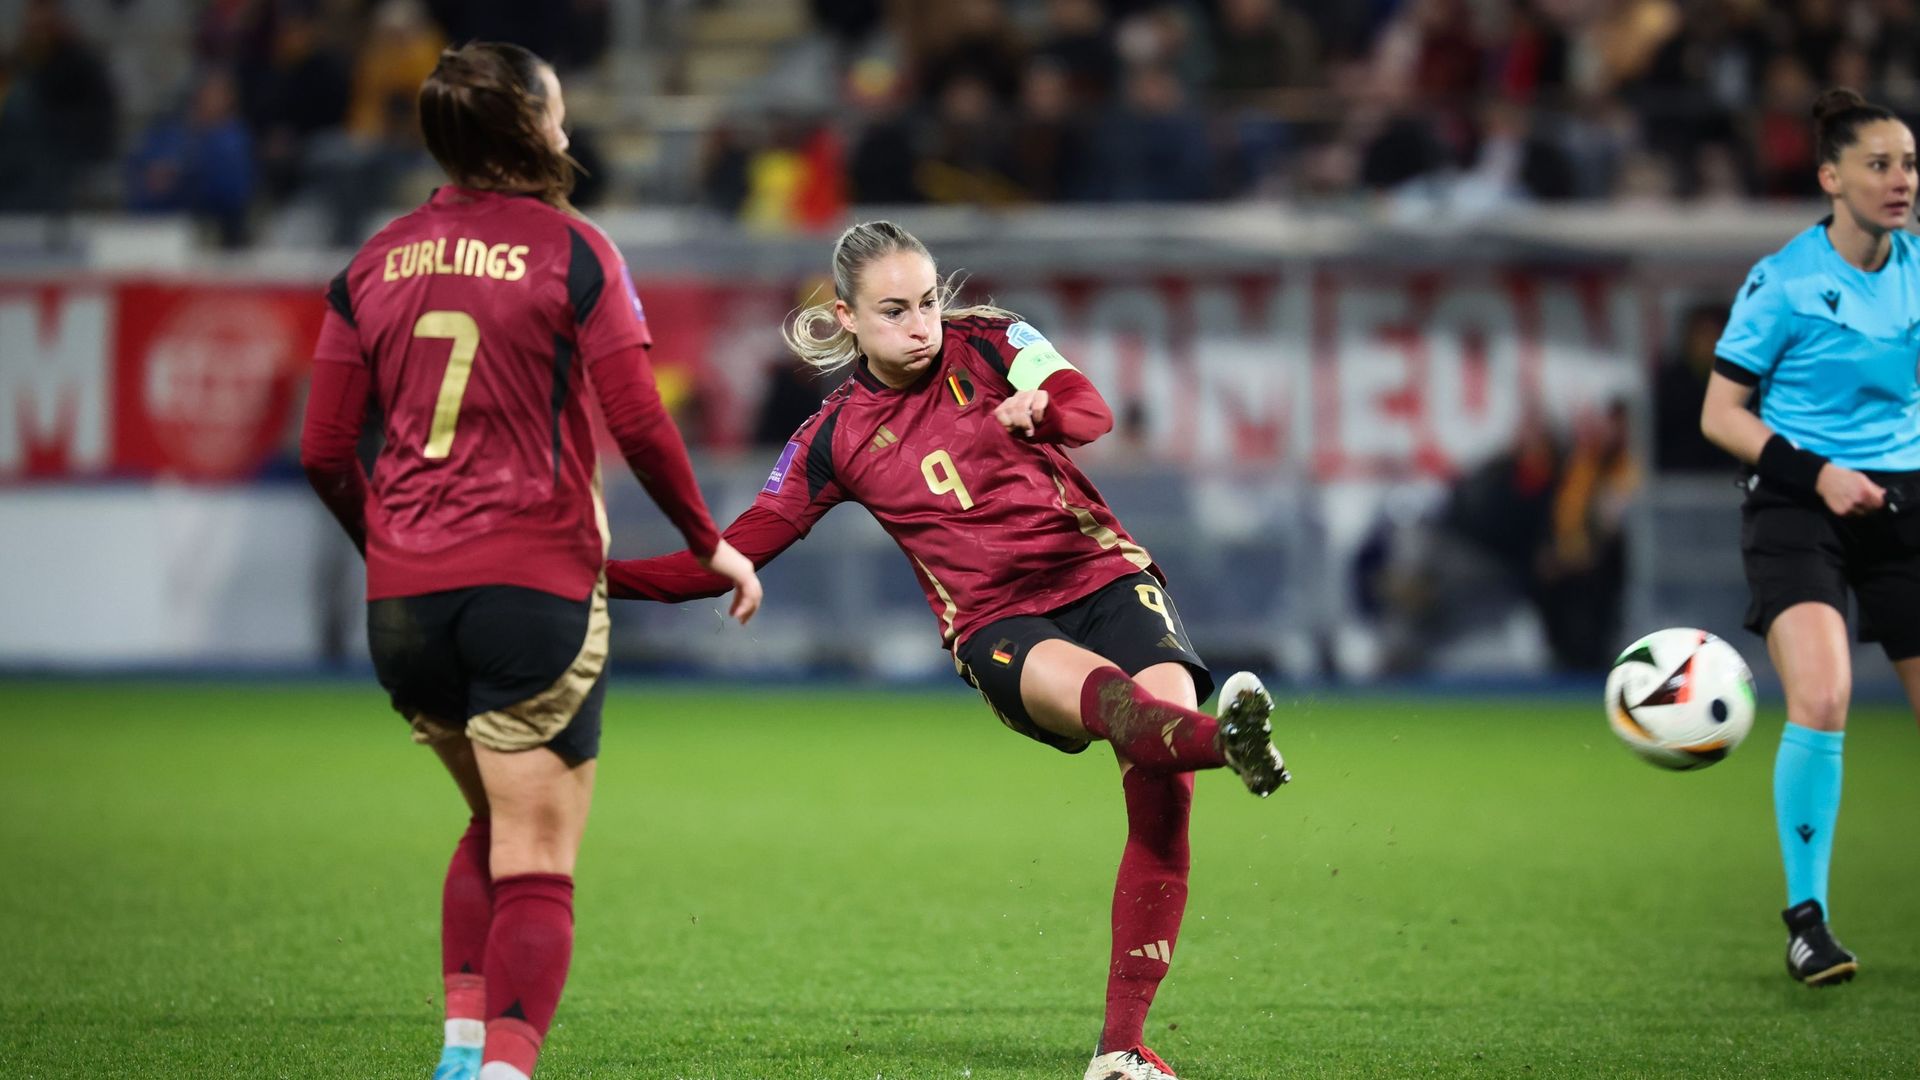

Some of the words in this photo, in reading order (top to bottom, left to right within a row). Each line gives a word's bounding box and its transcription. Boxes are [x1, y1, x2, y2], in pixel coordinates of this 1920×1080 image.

[383, 237, 530, 282] EURLINGS
[413, 310, 480, 459] 7
[919, 449, 975, 511] 9
[1134, 583, 1177, 635] 9
